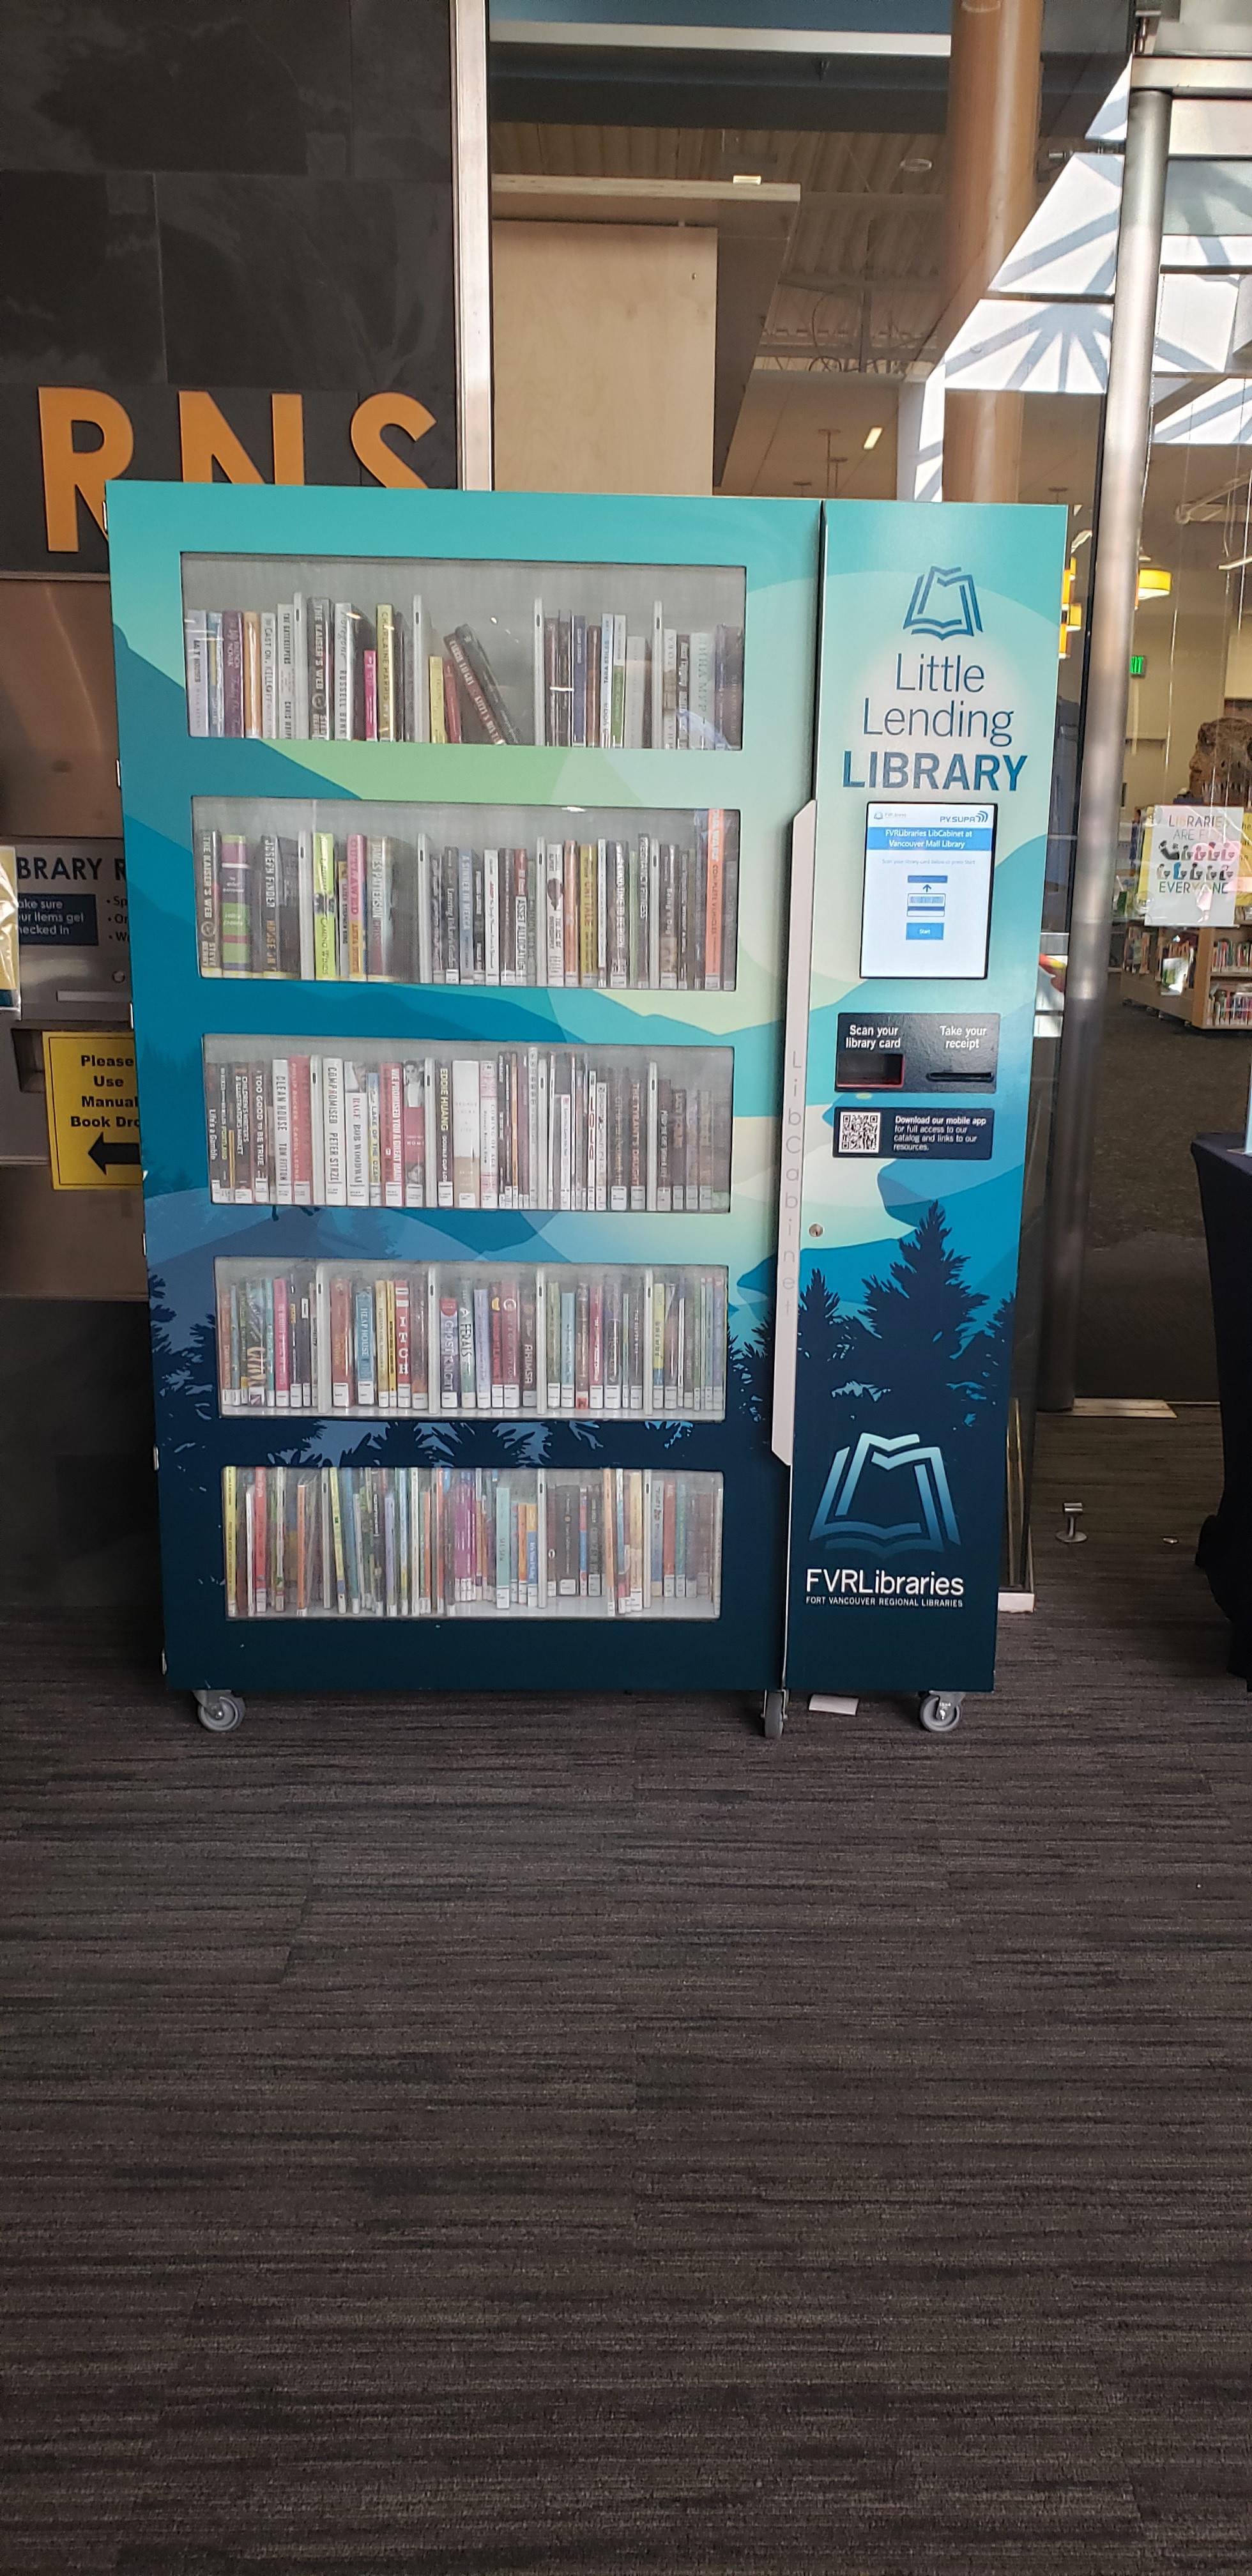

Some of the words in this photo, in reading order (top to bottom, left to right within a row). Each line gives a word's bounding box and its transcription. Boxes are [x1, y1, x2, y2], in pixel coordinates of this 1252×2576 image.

[264, 627, 273, 646] CAST
[896, 653, 984, 693] Little
[863, 698, 1014, 747] Lending
[843, 751, 1028, 791] LIBRARY
[942, 840, 965, 849] Library
[1173, 829, 1195, 841] ARE
[265, 840, 274, 873] JOSEPH
[372, 843, 381, 869] JAMES
[17, 857, 102, 880] BRARY
[203, 855, 211, 895] KAISER'S
[349, 838, 359, 914] OUTLAWED
[266, 877, 275, 907] FINDER
[372, 871, 382, 917] PATTERSON
[462, 893, 470, 901] IN
[41, 900, 63, 909] sure
[204, 899, 212, 918] WEB
[517, 900, 526, 923] ASSET
[66, 912, 84, 924] get
[850, 1025, 874, 1035] Scan
[877, 1027, 898, 1037] your
[940, 1025, 962, 1036] Take
[965, 1027, 987, 1038] your
[845, 1038, 876, 1050] library
[879, 1038, 901, 1048] card
[945, 1039, 980, 1050] receipt
[81, 1055, 134, 1066] Please
[93, 1075, 124, 1087] Use
[392, 1068, 400, 1081] WE
[439, 1068, 448, 1095] EDDIE
[277, 1076, 286, 1101] CLEAN
[328, 1067, 338, 1124] COMPROMISED
[82, 1096, 139, 1107] Manual
[71, 1116, 110, 1127] Book
[209, 1109, 217, 1128] Life's
[277, 1105, 287, 1131] HOUSE
[392, 1119, 401, 1133] YOU
[895, 1116, 930, 1124] Download
[257, 1131, 264, 1142] BE
[329, 1132, 339, 1156] PETER
[372, 1130, 378, 1140] OF
[894, 1135, 920, 1143] catalog
[210, 1135, 218, 1160] Gamble
[360, 1308, 369, 1328] HEAP
[399, 1317, 409, 1374] ITCH
[445, 1320, 454, 1353] GHOST
[524, 1344, 533, 1384] AHIMSA
[806, 1568, 964, 1595] FVRLibraries
[805, 1597, 825, 1605] FORT
[829, 1597, 875, 1606] VANCOUVER
[878, 1597, 919, 1607] REGIONAL
[921, 1598, 963, 1607] LIBRARIES
